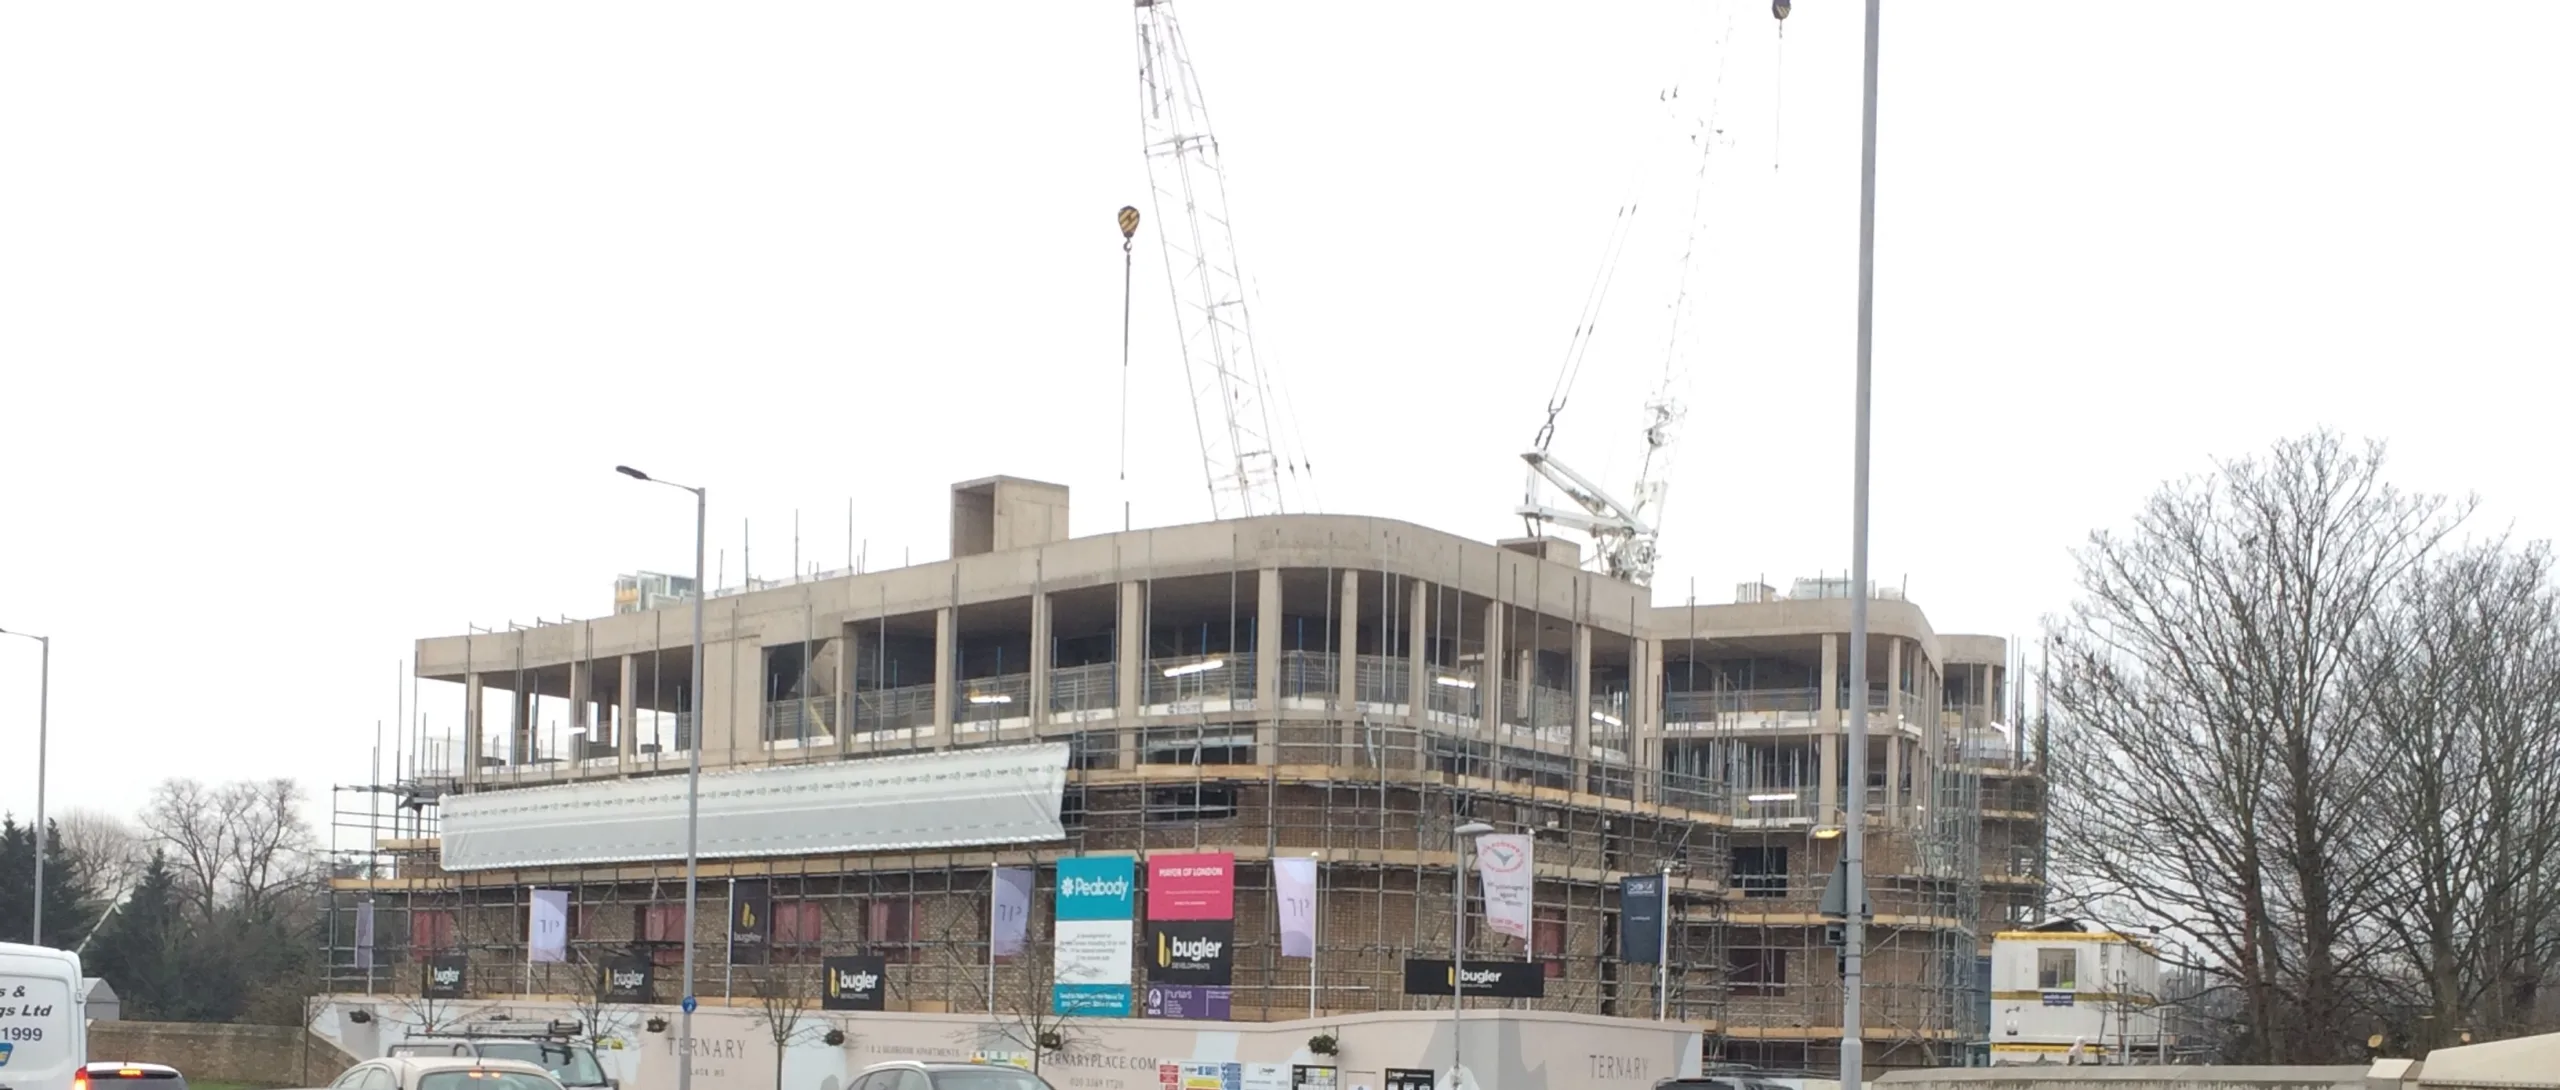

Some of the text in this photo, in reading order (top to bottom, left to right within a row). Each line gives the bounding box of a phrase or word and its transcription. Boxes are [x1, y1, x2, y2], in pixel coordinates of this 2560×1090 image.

[1183, 867, 1192, 877] OF
[1193, 867, 1222, 876] LONDON
[1075, 875, 1129, 901] Peabody
[1172, 936, 1222, 961] bugler
[434, 967, 460, 985] bugler
[613, 970, 645, 986] bugler
[840, 970, 878, 992] bugler
[1461, 968, 1502, 984] bugler
[13, 985, 25, 998] &
[22, 1004, 52, 1017] Ltd
[2, 1027, 43, 1042] 1999
[1589, 1054, 1649, 1080] TERNARY
